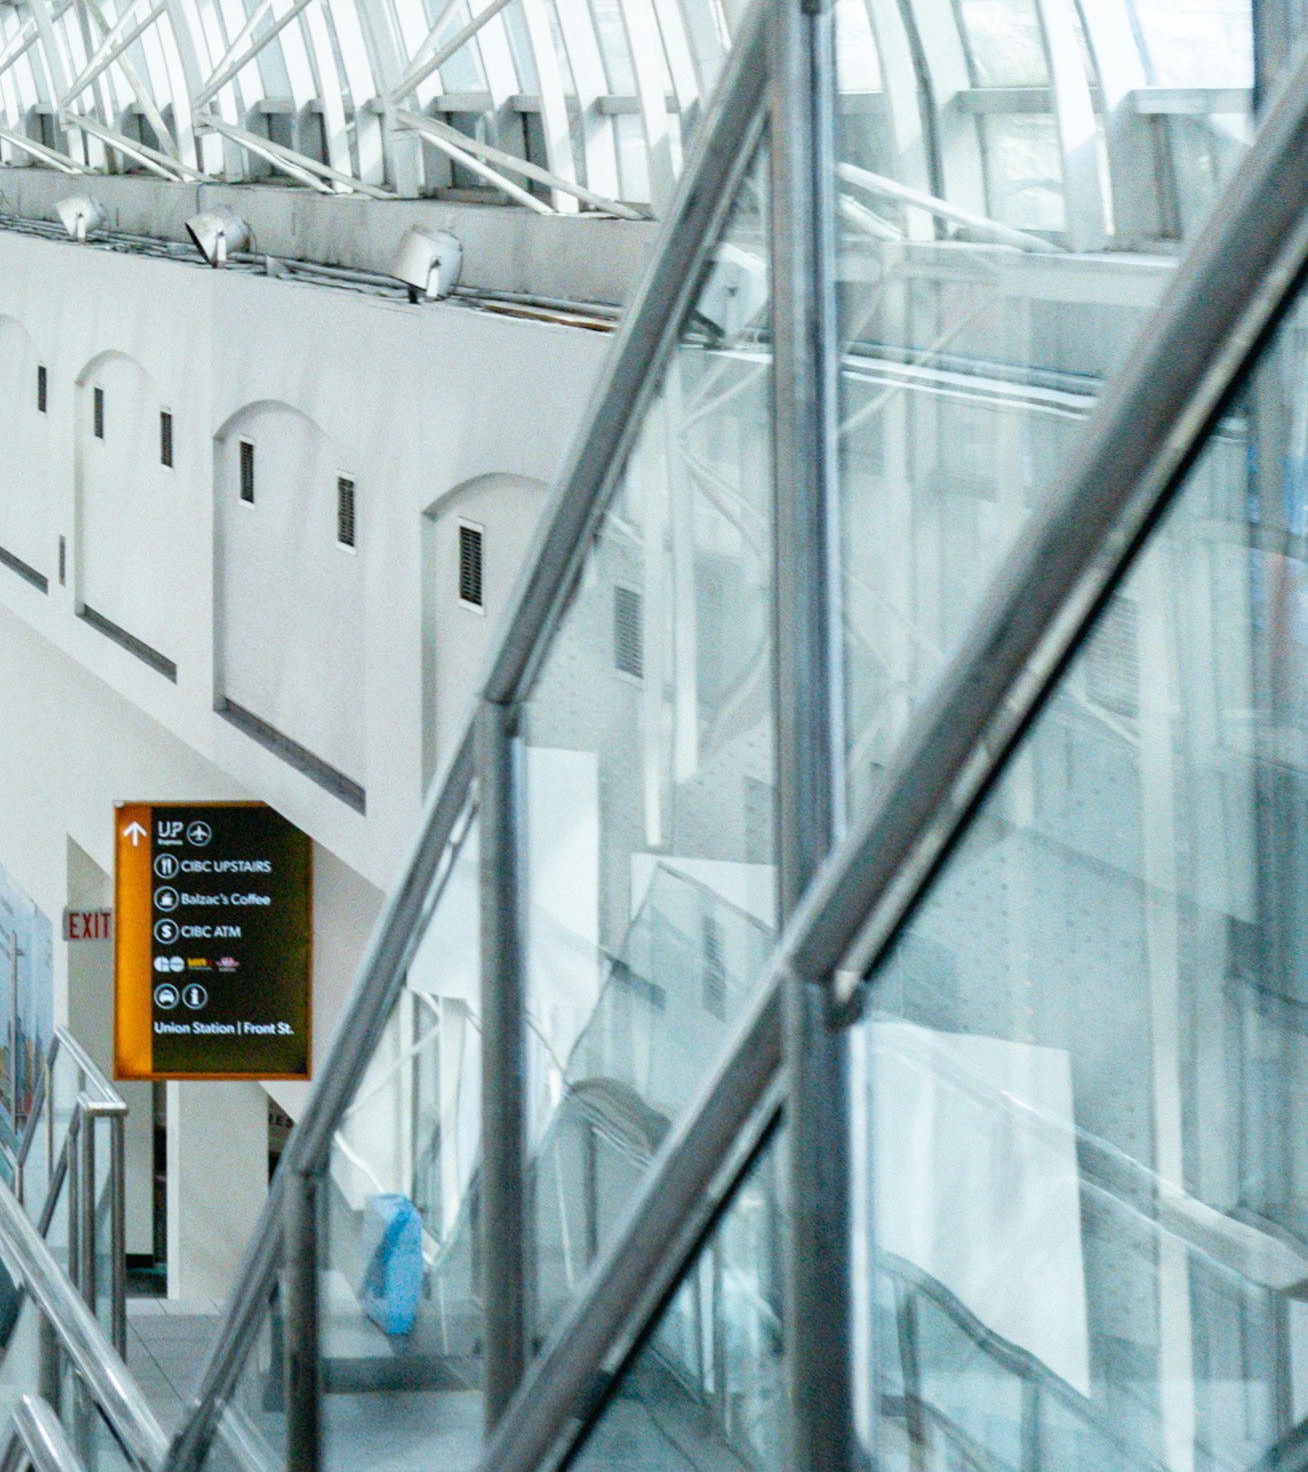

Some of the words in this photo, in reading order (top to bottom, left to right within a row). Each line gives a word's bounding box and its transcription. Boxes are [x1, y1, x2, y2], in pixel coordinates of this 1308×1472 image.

[157, 820, 184, 837] UP
[181, 860, 212, 873] CIBC
[213, 860, 272, 873] UPSTAIRS
[181, 892, 229, 905] Balzac's
[230, 892, 271, 905] Coffee
[69, 912, 111, 939] EXIT
[181, 925, 212, 938] CIBC
[213, 925, 242, 938] ATM
[154, 1022, 191, 1034] Union
[192, 1021, 235, 1034] Station
[243, 1022, 276, 1034] Front
[277, 1022, 295, 1035] St.
